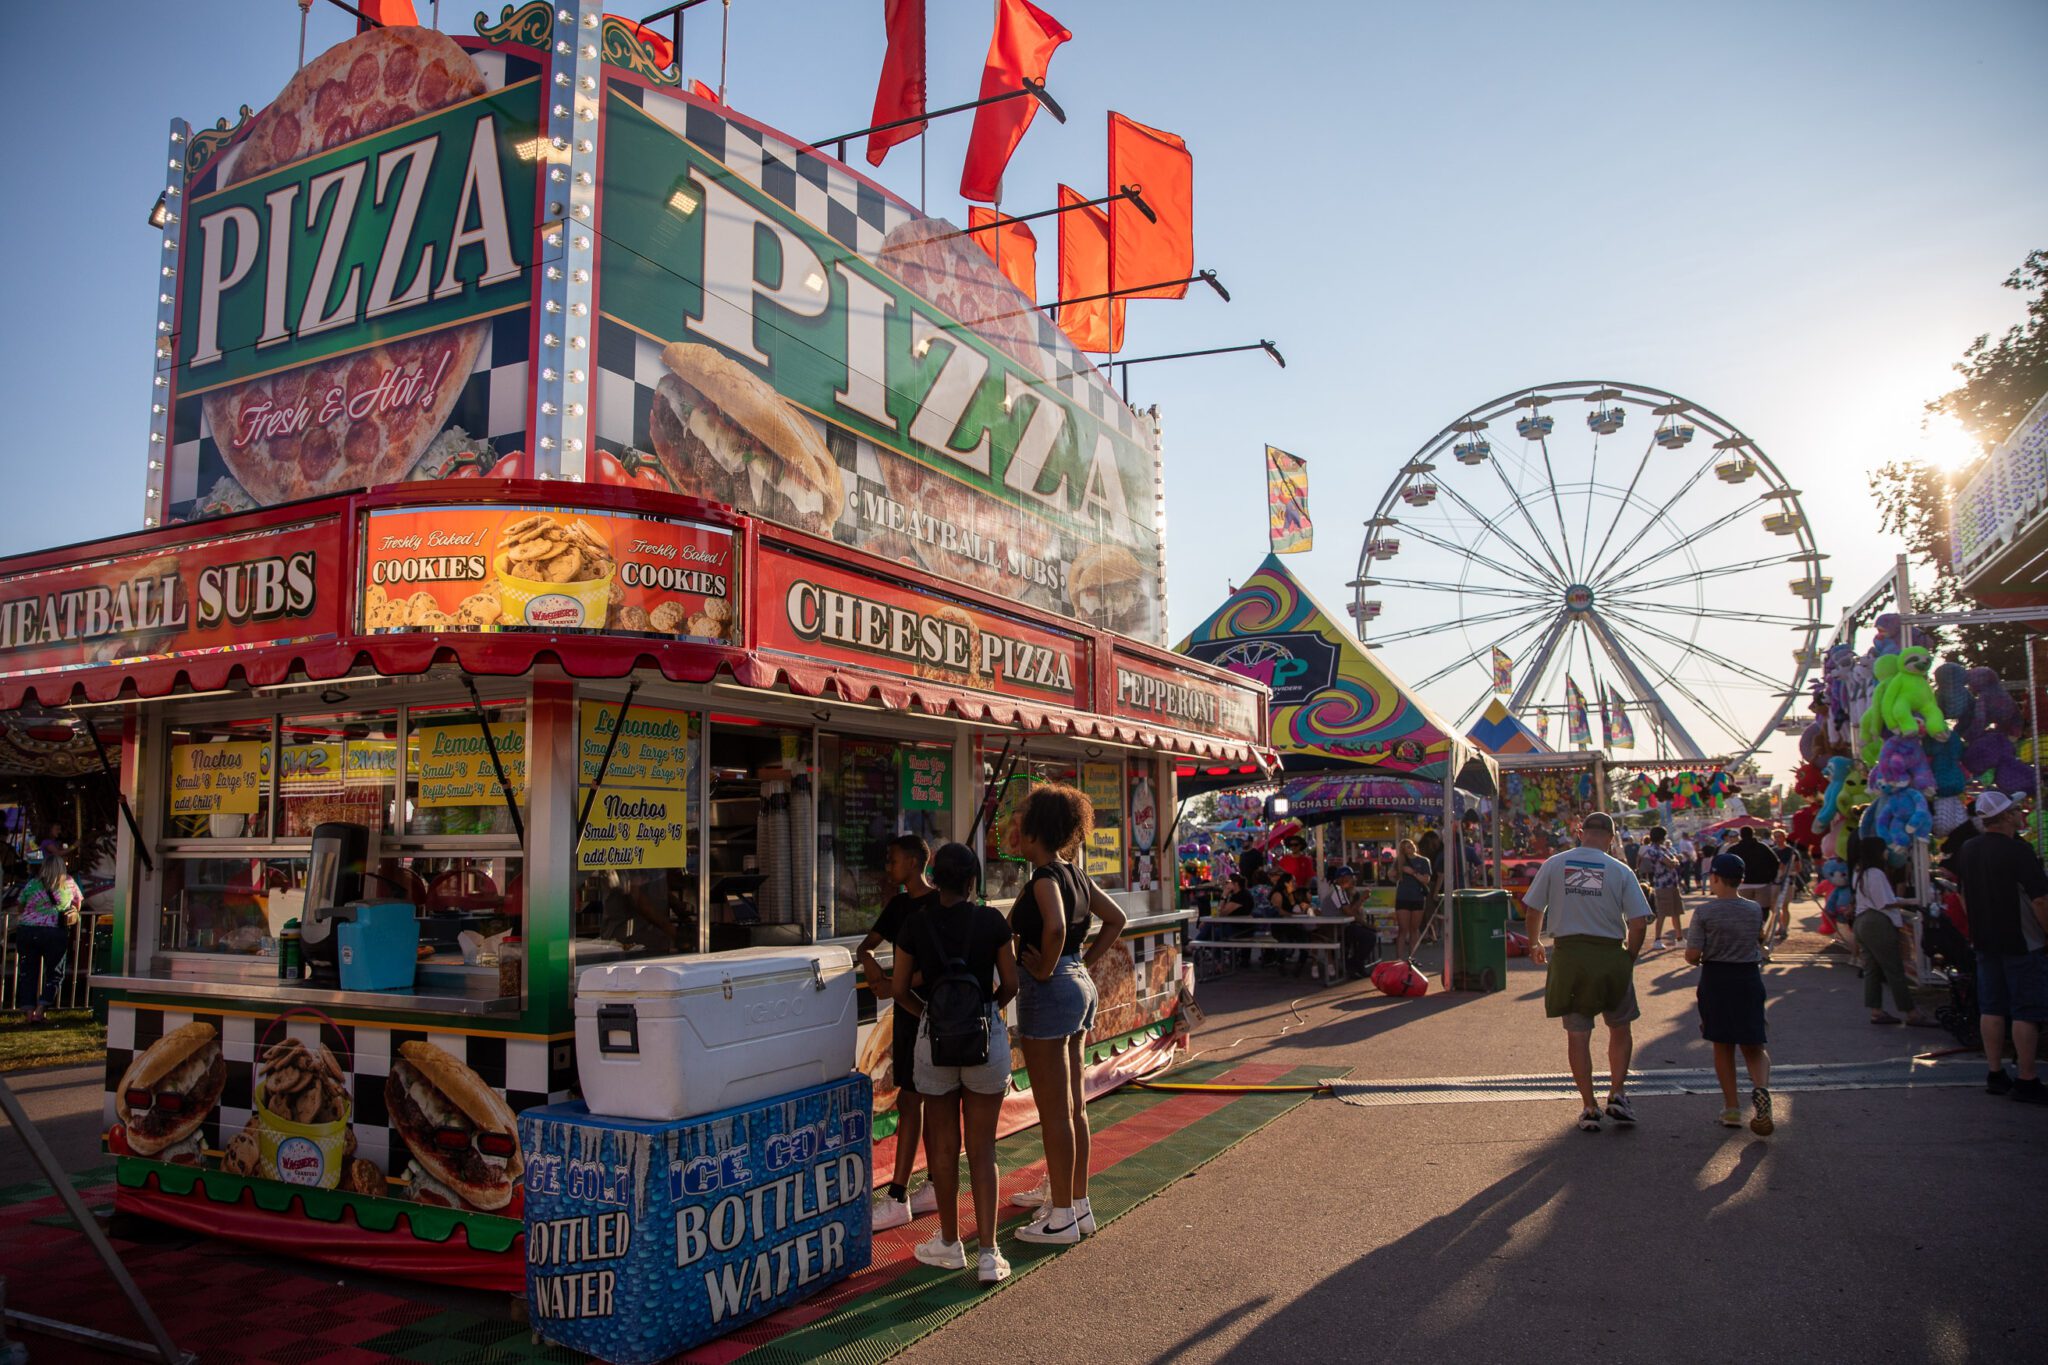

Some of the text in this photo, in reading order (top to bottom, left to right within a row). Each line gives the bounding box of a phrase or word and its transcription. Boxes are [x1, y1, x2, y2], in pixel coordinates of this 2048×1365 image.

[188, 114, 523, 369] PIZZA
[684, 169, 1140, 547] PIZZA
[233, 396, 313, 447] Fresh
[318, 386, 345, 425] &
[377, 534, 422, 552] Freshly
[627, 539, 678, 561] Freshly
[863, 489, 1058, 590] MEATBALL SUBS
[371, 556, 486, 584] COOKIES
[621, 562, 727, 598] COOKIES
[198, 553, 315, 624] SUBS
[787, 581, 1074, 693] CHEESE PIZZA
[1116, 667, 1216, 724] PEPPERONI
[1272, 684, 1303, 692] OVIDERS
[594, 709, 682, 739] Lemonade
[431, 729, 523, 756] Lemonade
[583, 738, 618, 758] Sma
[638, 744, 669, 765] Large
[191, 749, 242, 770] Nachos
[422, 761, 454, 779] Small
[455, 761, 468, 777] $8
[477, 759, 511, 777] Lae
[582, 760, 609, 781] Refi
[608, 762, 634, 778] Small
[650, 766, 675, 785] Large
[908, 755, 946, 775] Thank You
[175, 773, 199, 790] Small
[215, 771, 242, 795] Large
[422, 783, 446, 802] Refill
[446, 783, 474, 798] Small
[490, 782, 518, 797] Lae
[913, 771, 942, 787] Have A
[174, 796, 191, 810] add
[192, 794, 213, 810] Chili
[603, 794, 667, 820] Nachos
[911, 786, 944, 806] Nice Day
[1288, 797, 1444, 810] RCHASE AND RELOAD HER
[583, 822, 682, 847] Small $8 Large $15
[583, 845, 645, 864] add Chili $1
[1564, 887, 1602, 897] patagonia
[669, 1109, 867, 1203] ICE COLD
[525, 1150, 630, 1206] CE COLD
[675, 1152, 867, 1269] BOTTLED
[529, 1209, 632, 1266] BOTTLED
[704, 1221, 847, 1324] WATER
[534, 1269, 617, 1320] WATER
